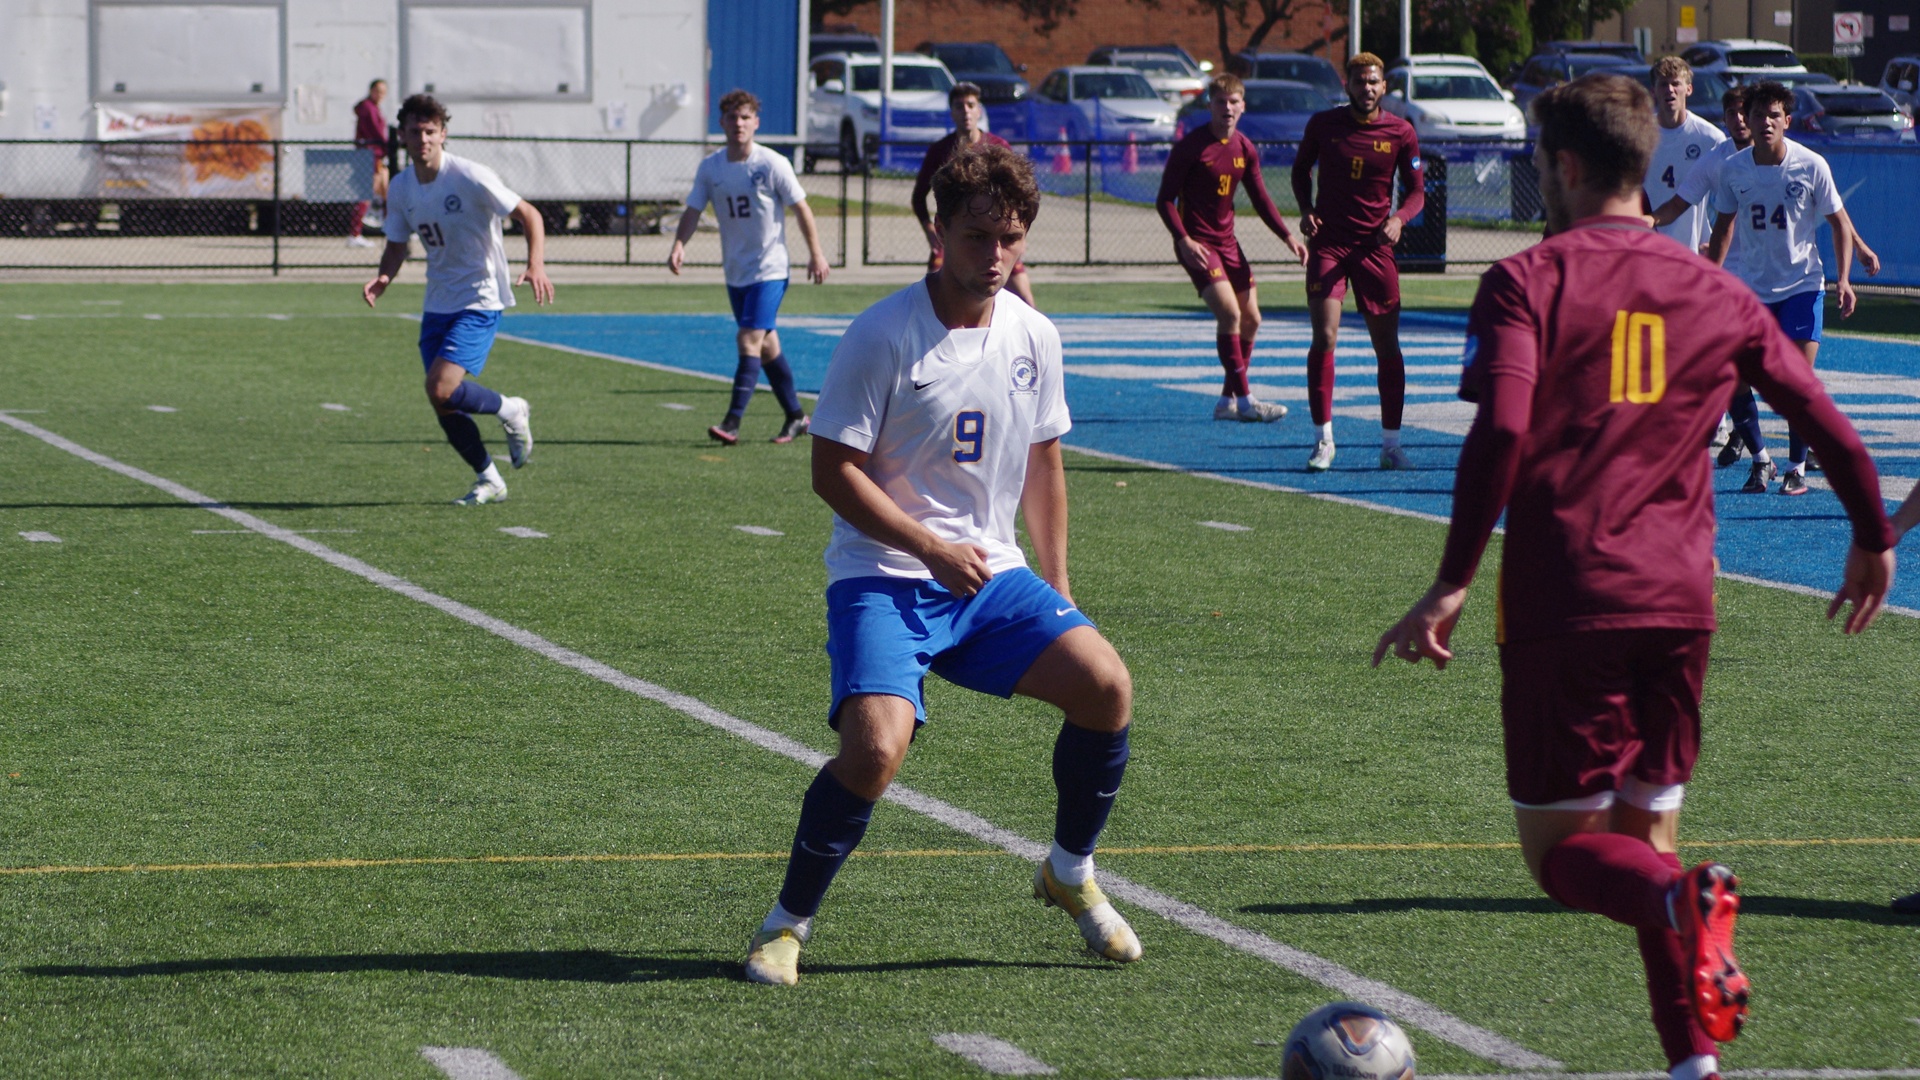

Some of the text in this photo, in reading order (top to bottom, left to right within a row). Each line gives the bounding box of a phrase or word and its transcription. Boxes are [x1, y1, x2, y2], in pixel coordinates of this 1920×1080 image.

[1350, 156, 1364, 180] 9
[1661, 165, 1675, 189] 4
[1217, 174, 1232, 196] 31
[726, 195, 751, 218] 12
[1751, 203, 1787, 230] 24
[418, 222, 445, 247] 21
[1609, 309, 1667, 405] 10
[952, 408, 986, 465] 9
[1332, 1063, 1378, 1080] Wilson
